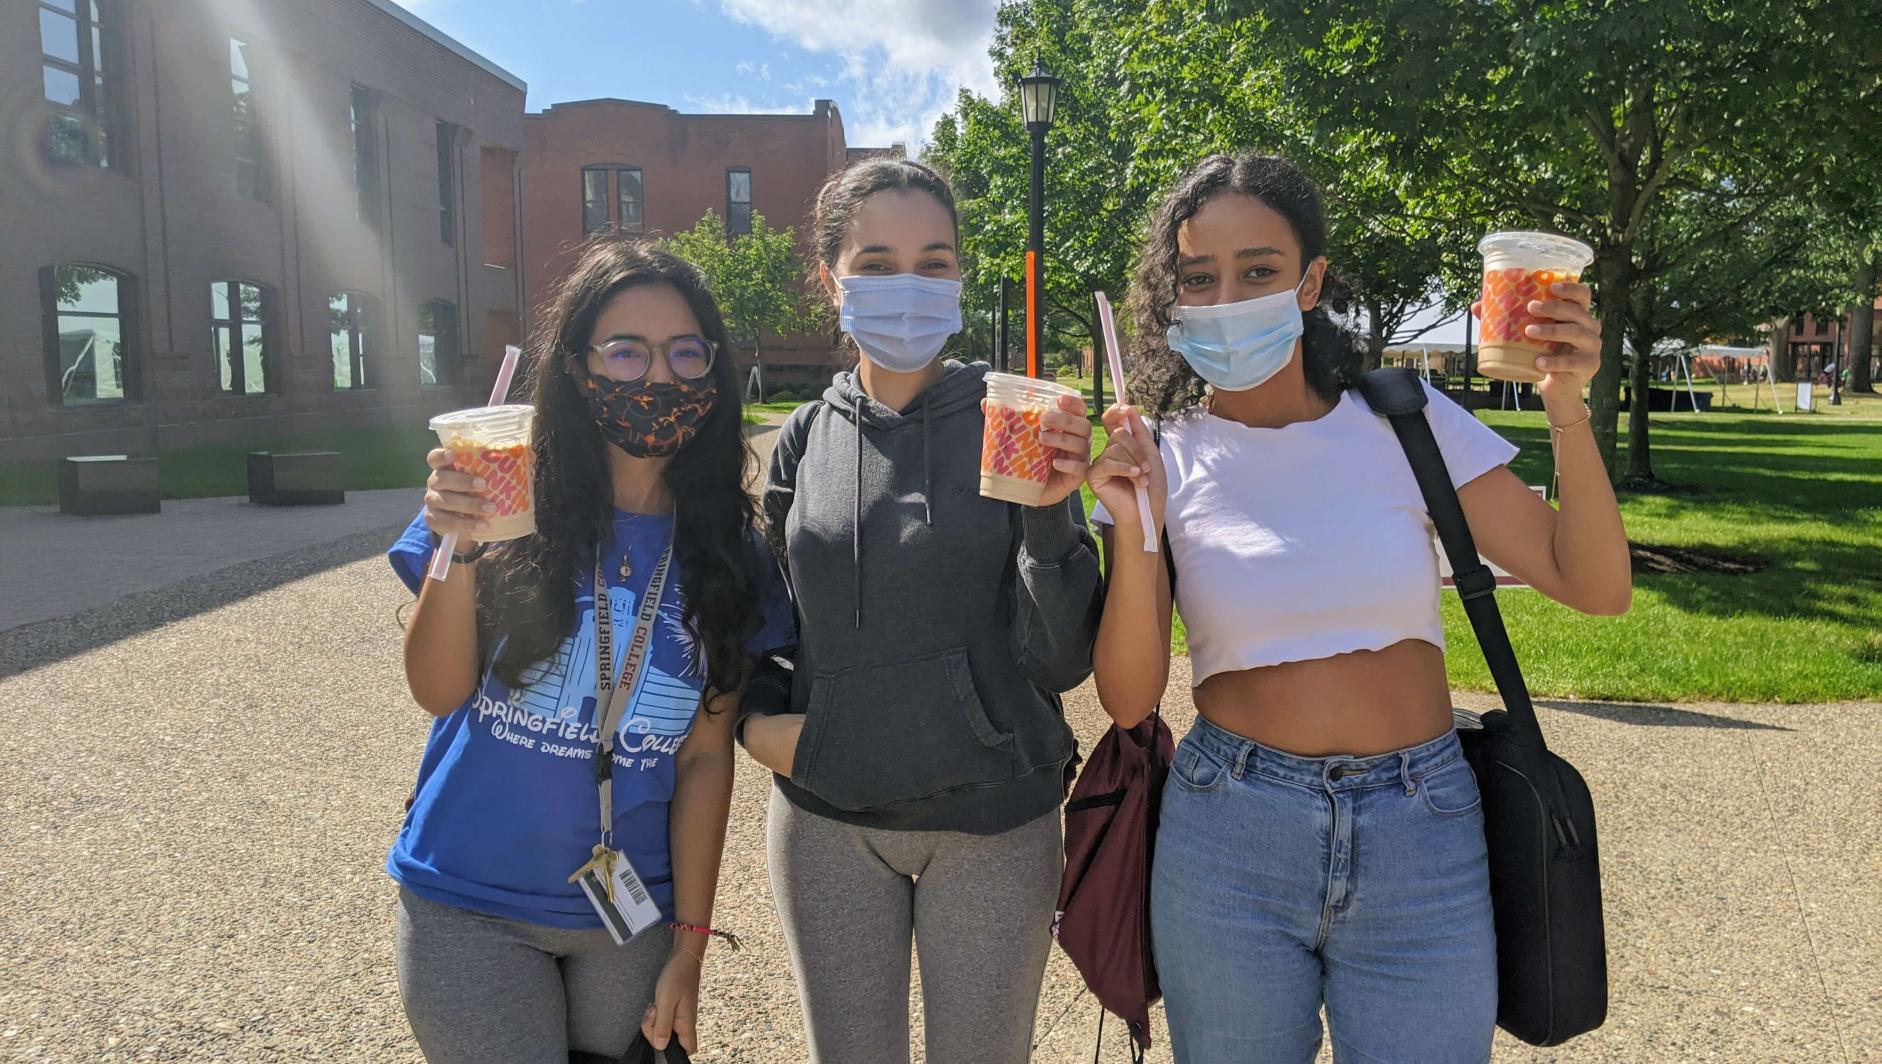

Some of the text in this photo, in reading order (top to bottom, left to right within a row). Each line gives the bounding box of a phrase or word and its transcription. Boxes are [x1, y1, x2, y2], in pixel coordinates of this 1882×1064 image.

[597, 593, 611, 690] SPRINGFIELD
[620, 625, 648, 691] COLLEGE
[491, 719, 536, 749] WHERE
[540, 742, 593, 760] DREAMS
[620, 718, 689, 755] COLLE
